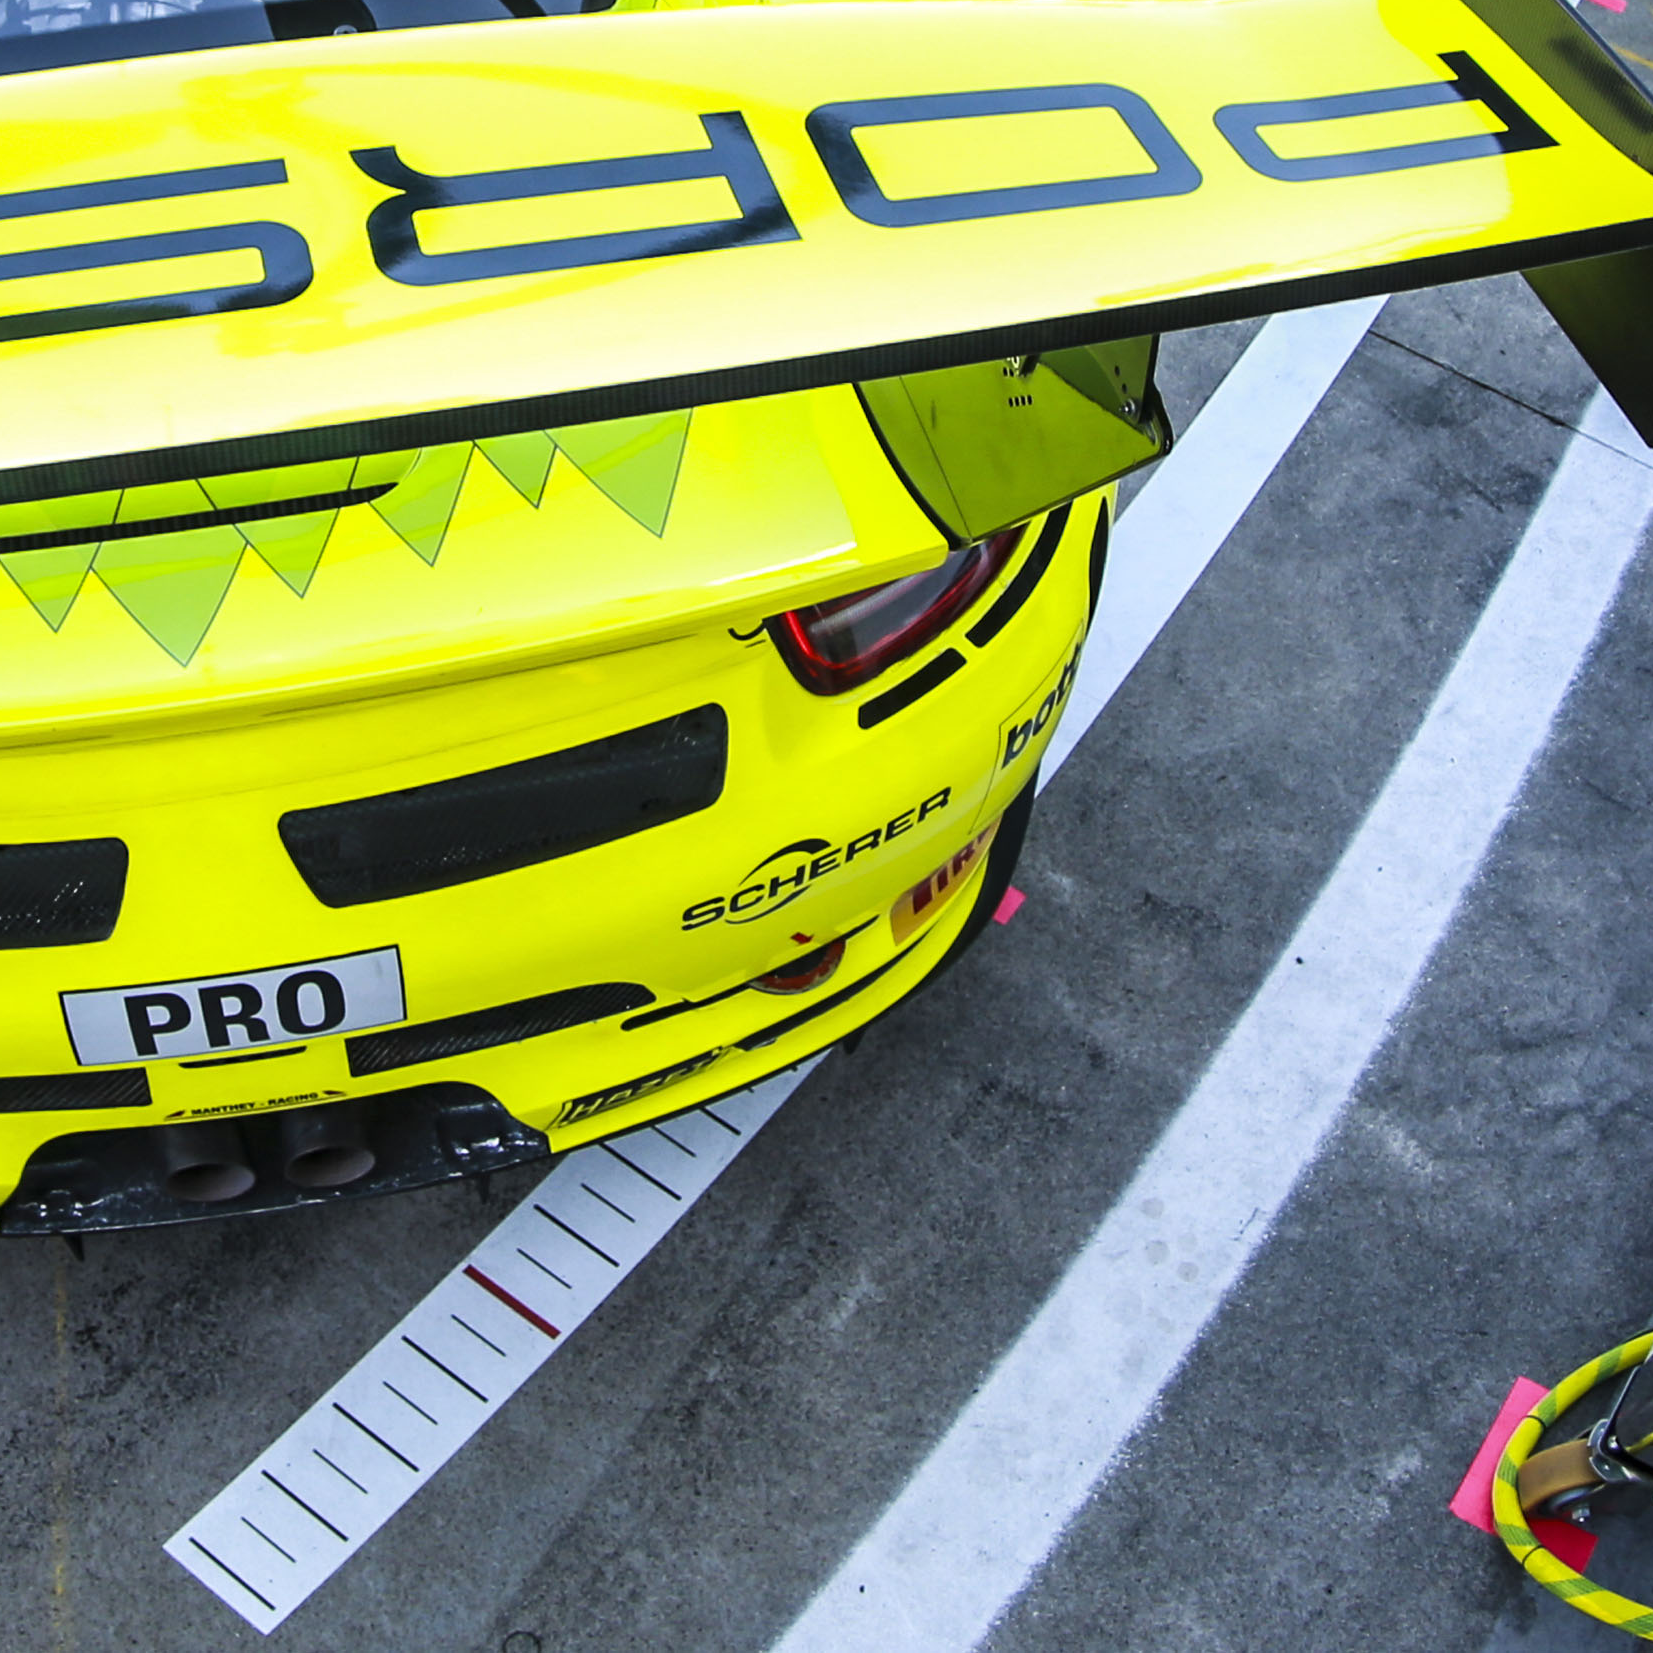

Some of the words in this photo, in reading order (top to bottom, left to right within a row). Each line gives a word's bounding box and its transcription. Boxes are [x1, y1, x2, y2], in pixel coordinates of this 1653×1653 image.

[680, 785, 952, 932] SCHERER
[123, 969, 347, 1058] PRO
[267, 1092, 319, 1107] RACING
